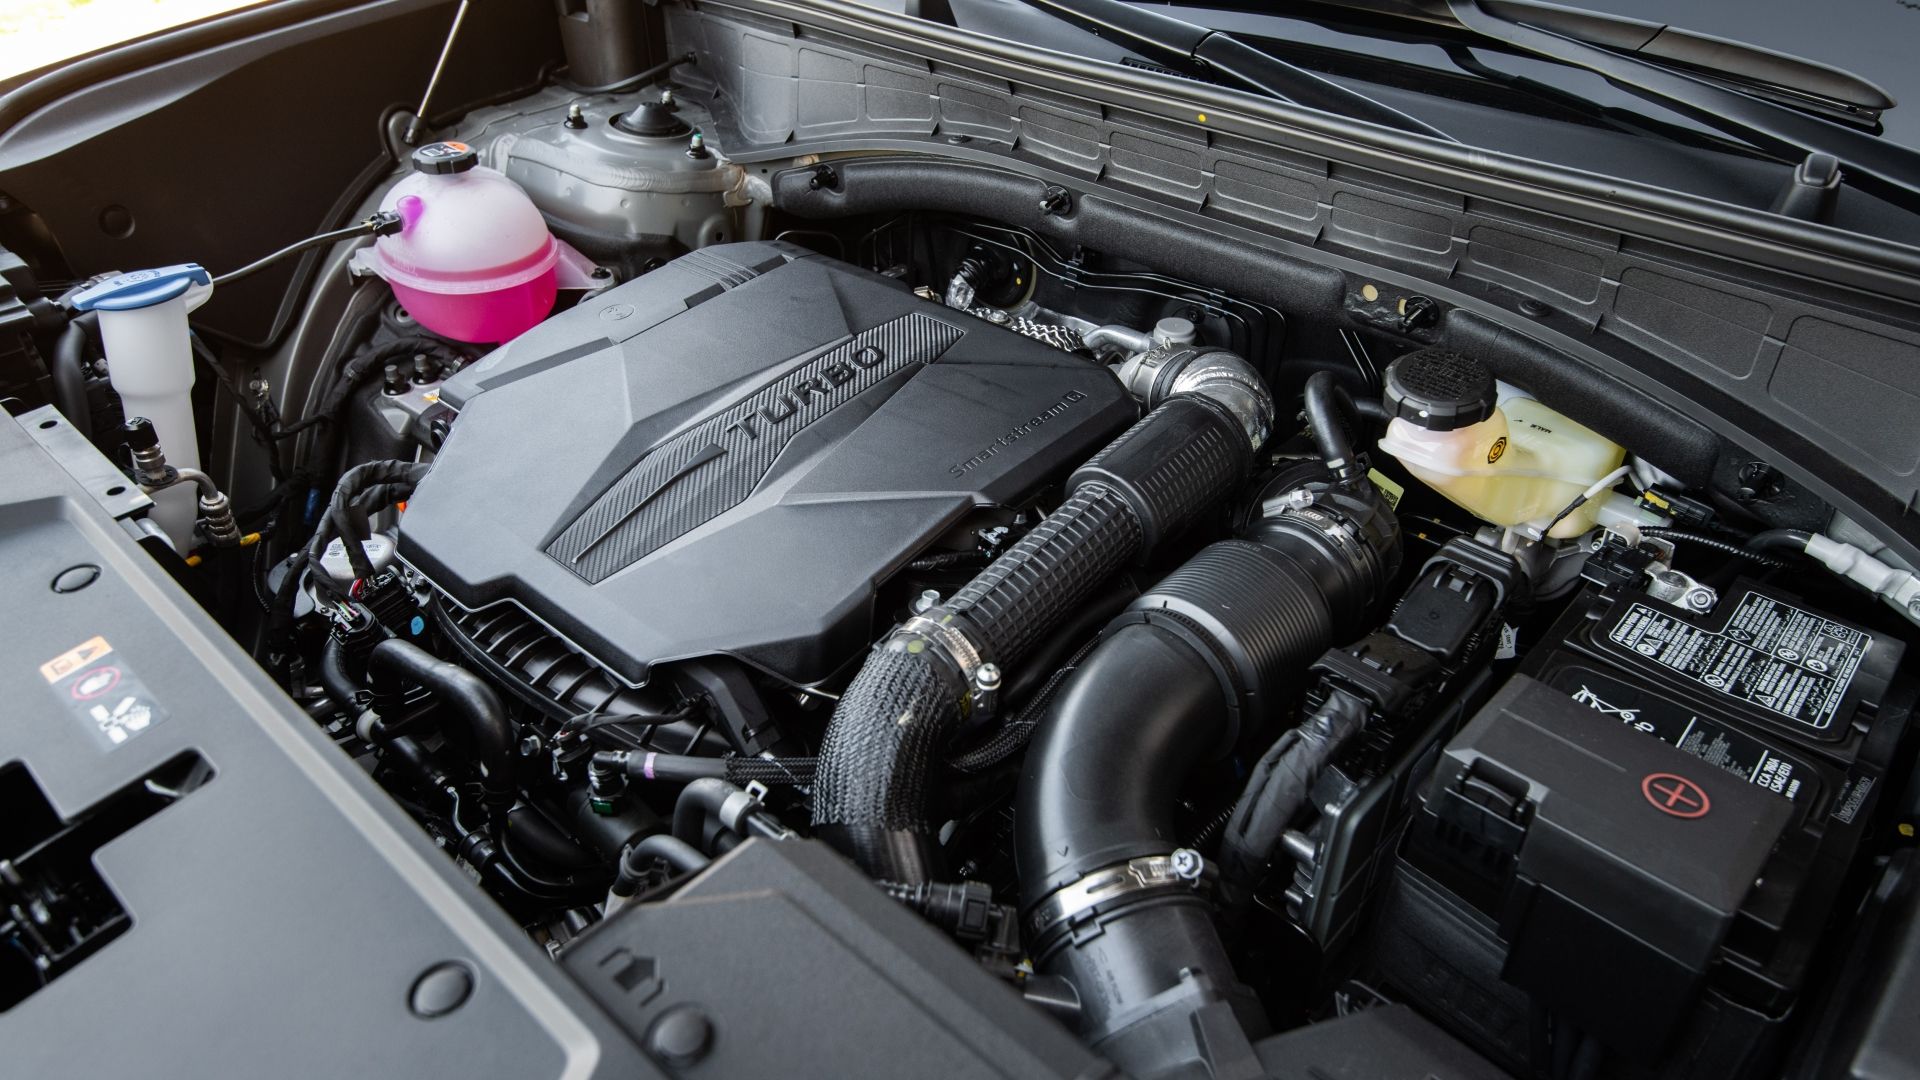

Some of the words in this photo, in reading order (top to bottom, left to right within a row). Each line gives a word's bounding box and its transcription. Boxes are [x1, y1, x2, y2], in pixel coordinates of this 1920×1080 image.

[725, 345, 885, 440] TURBO
[949, 400, 1069, 478] Smartstream
[1756, 772, 1773, 788] CCA
